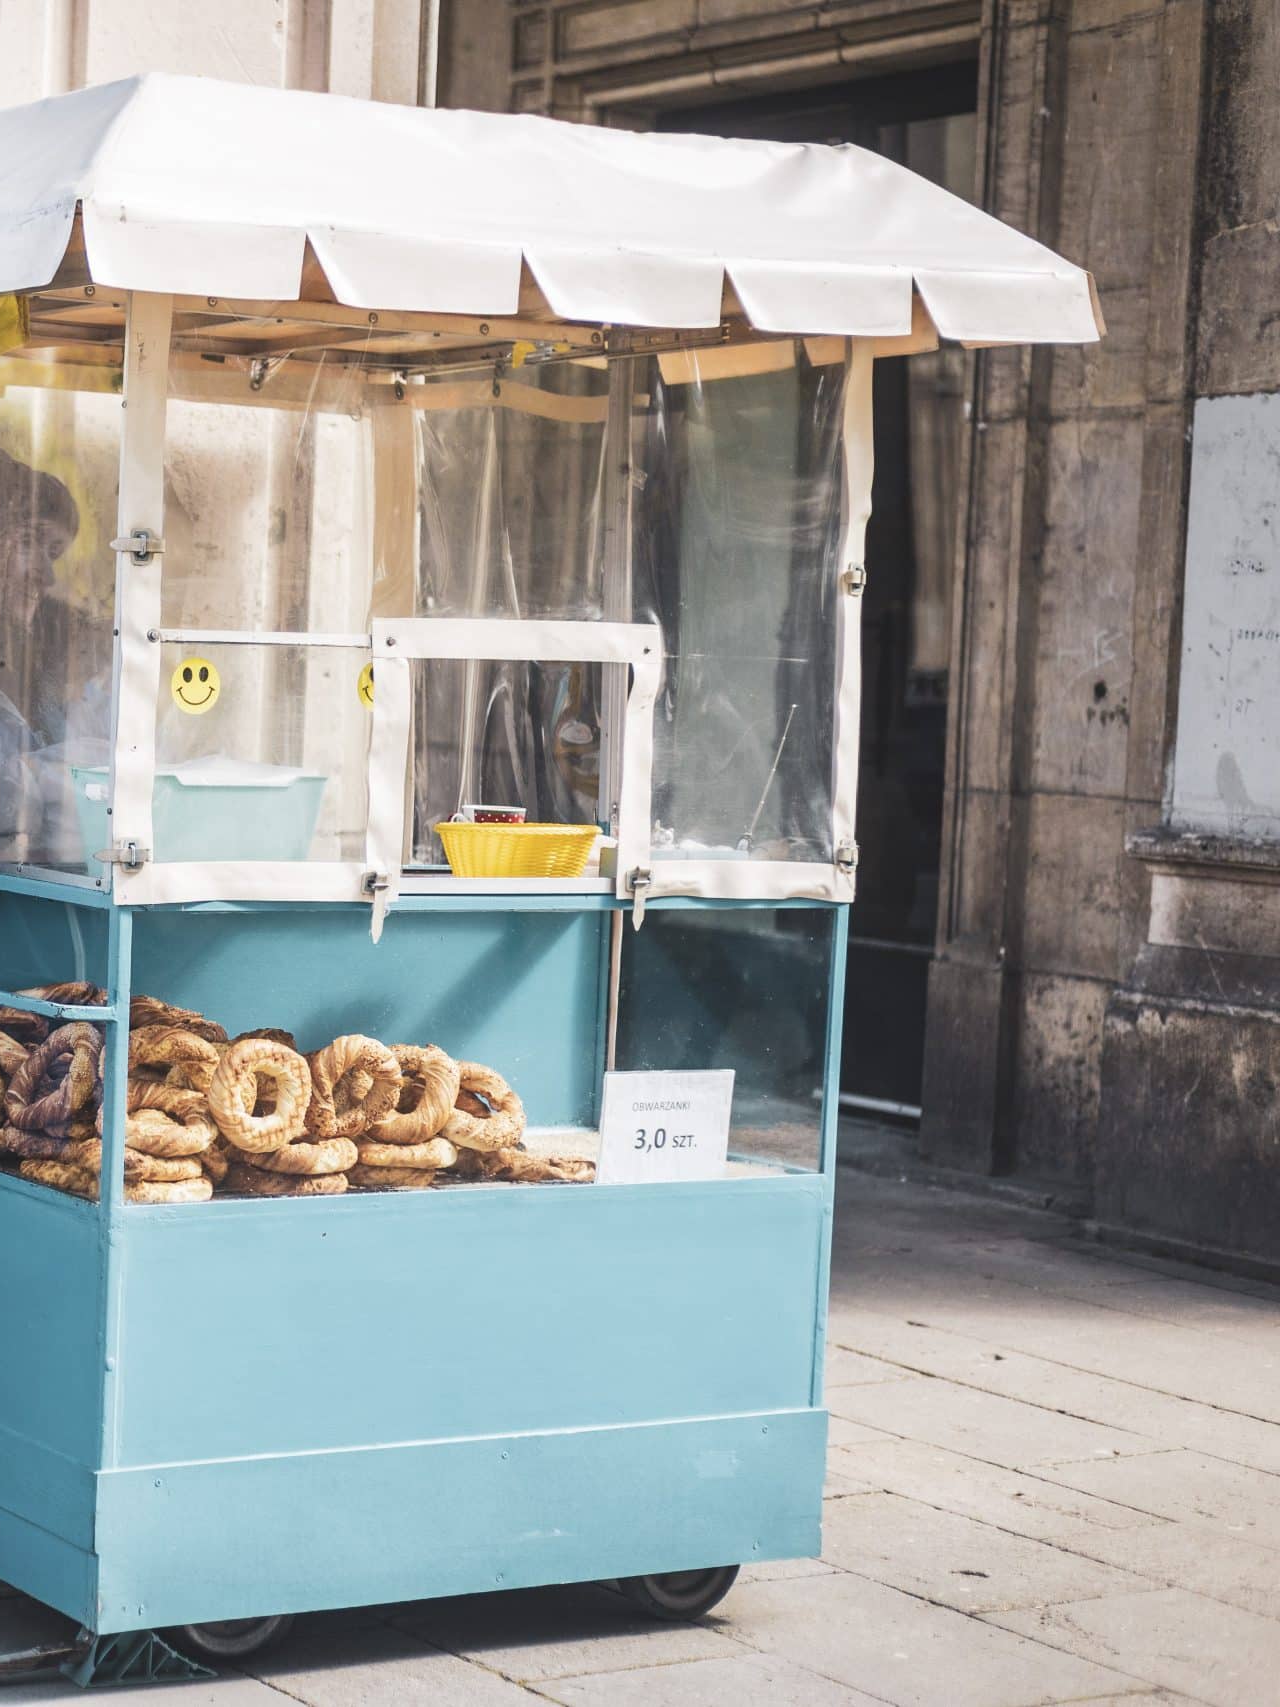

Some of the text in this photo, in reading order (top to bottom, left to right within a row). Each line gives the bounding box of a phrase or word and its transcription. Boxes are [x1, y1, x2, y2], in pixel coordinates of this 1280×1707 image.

[632, 1101, 691, 1112] OBWARZANKI
[634, 1128, 697, 1153] 3,0 SZT.
